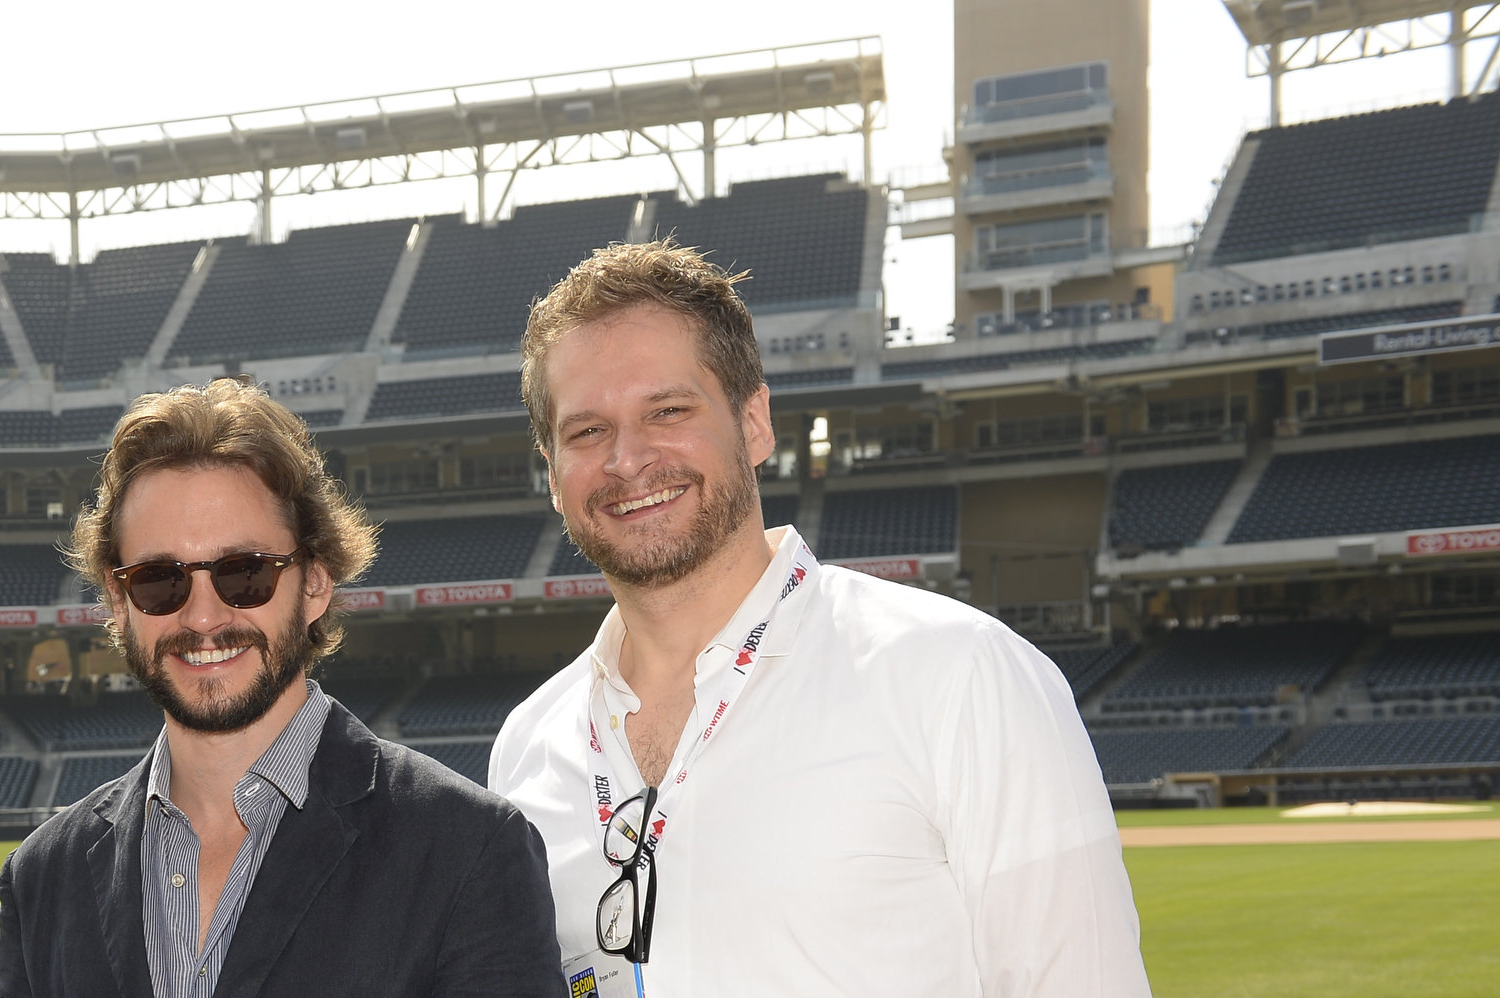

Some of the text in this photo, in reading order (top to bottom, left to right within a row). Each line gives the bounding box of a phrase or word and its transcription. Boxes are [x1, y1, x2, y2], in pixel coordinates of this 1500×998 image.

[1374, 327, 1431, 352] Rental
[1449, 531, 1500, 549] TOYO
[452, 583, 506, 600] TOYOTA
[594, 774, 612, 806] DEXTER
[580, 975, 596, 994] CON
